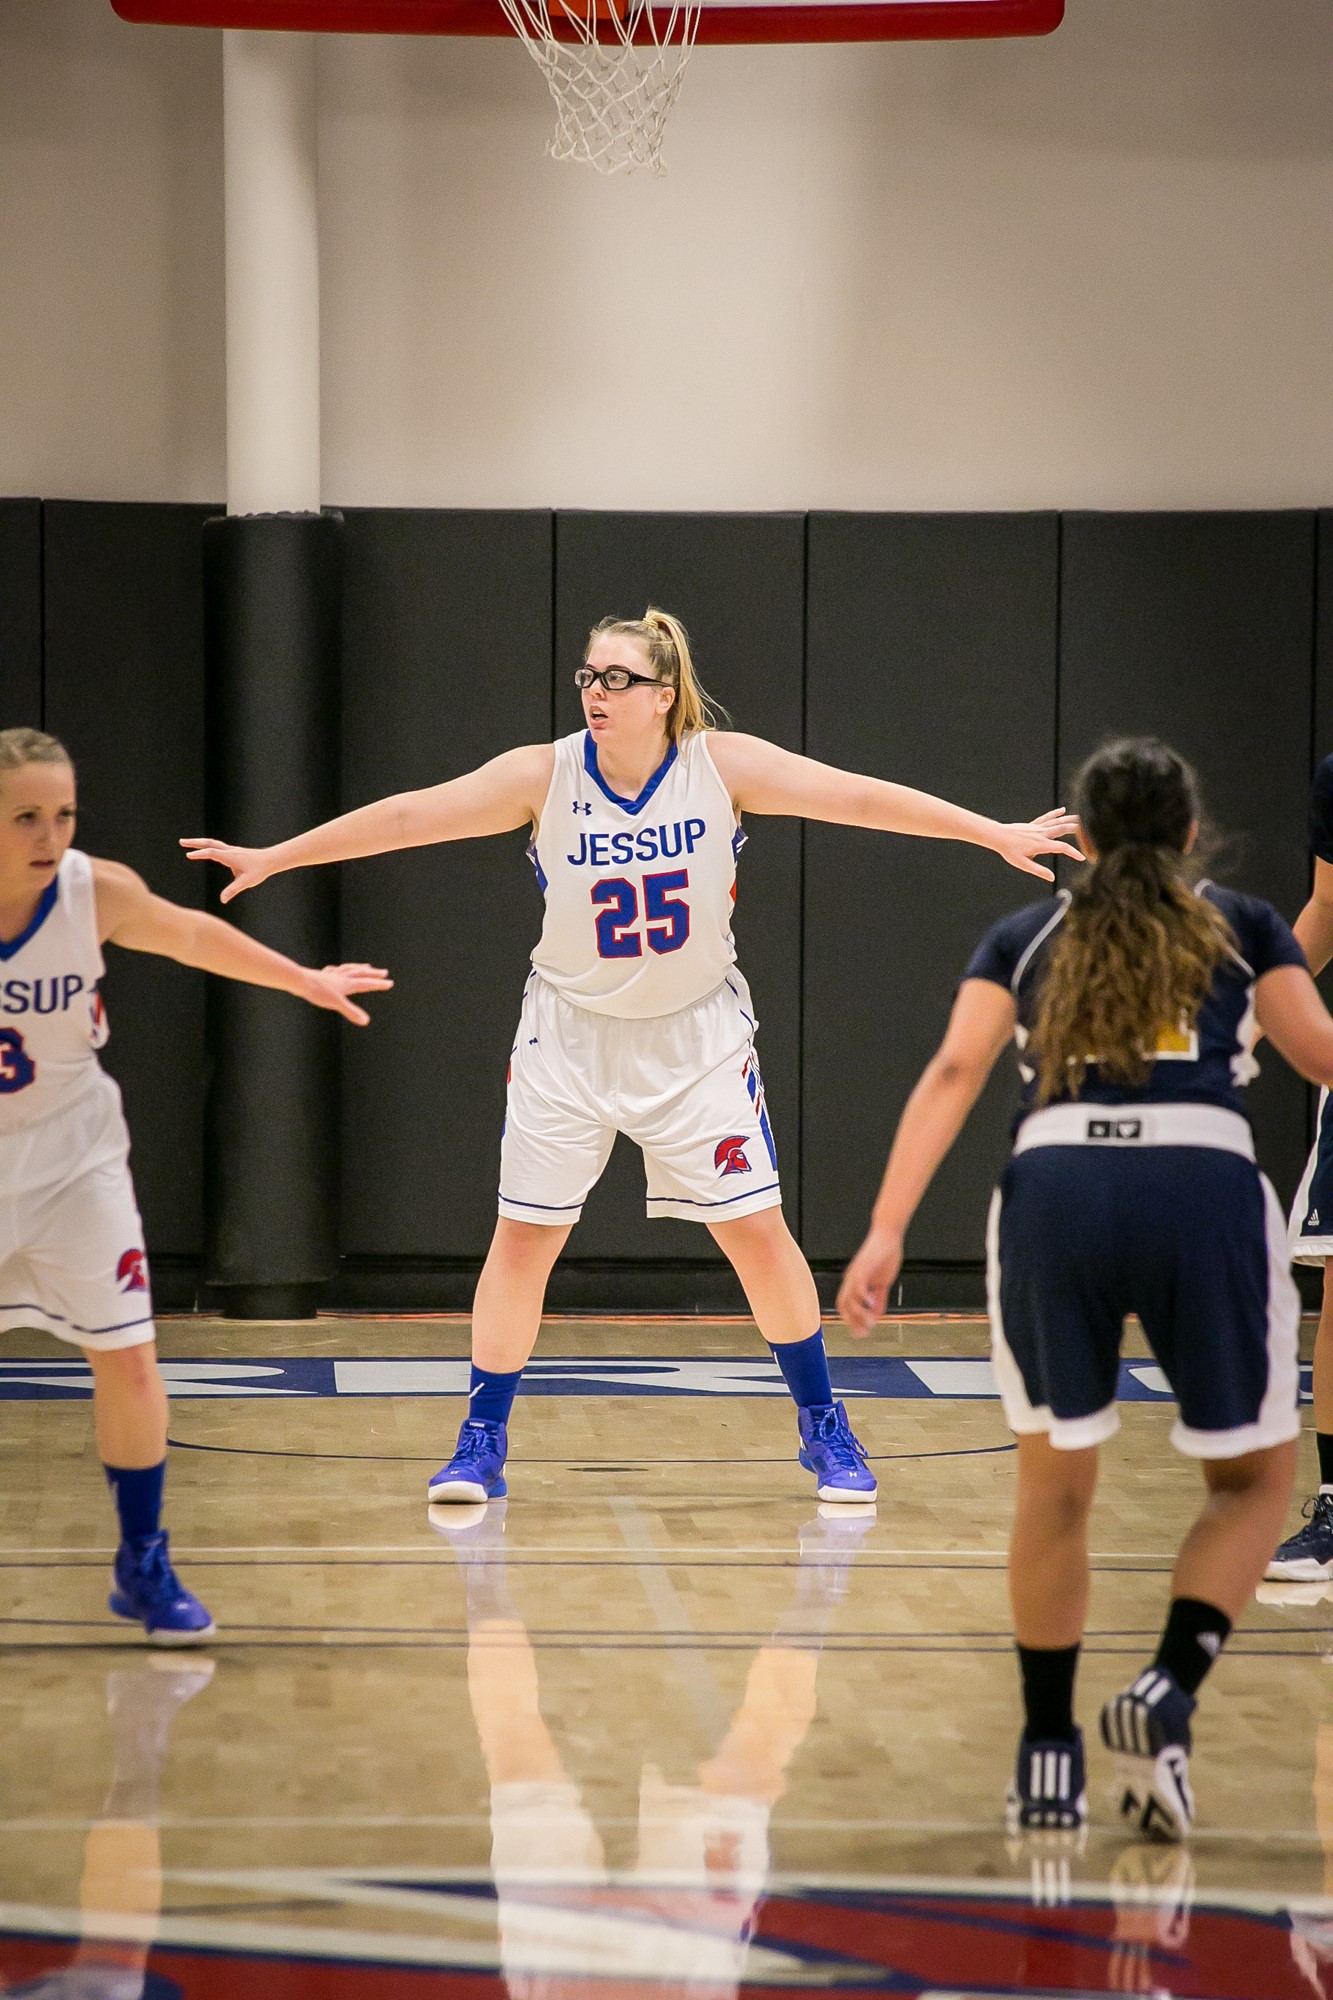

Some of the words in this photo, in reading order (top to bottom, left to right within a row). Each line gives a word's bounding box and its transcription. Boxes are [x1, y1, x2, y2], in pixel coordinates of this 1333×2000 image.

[567, 818, 706, 866] JESSUP
[590, 868, 690, 959] 25
[0, 974, 84, 1015] SUP
